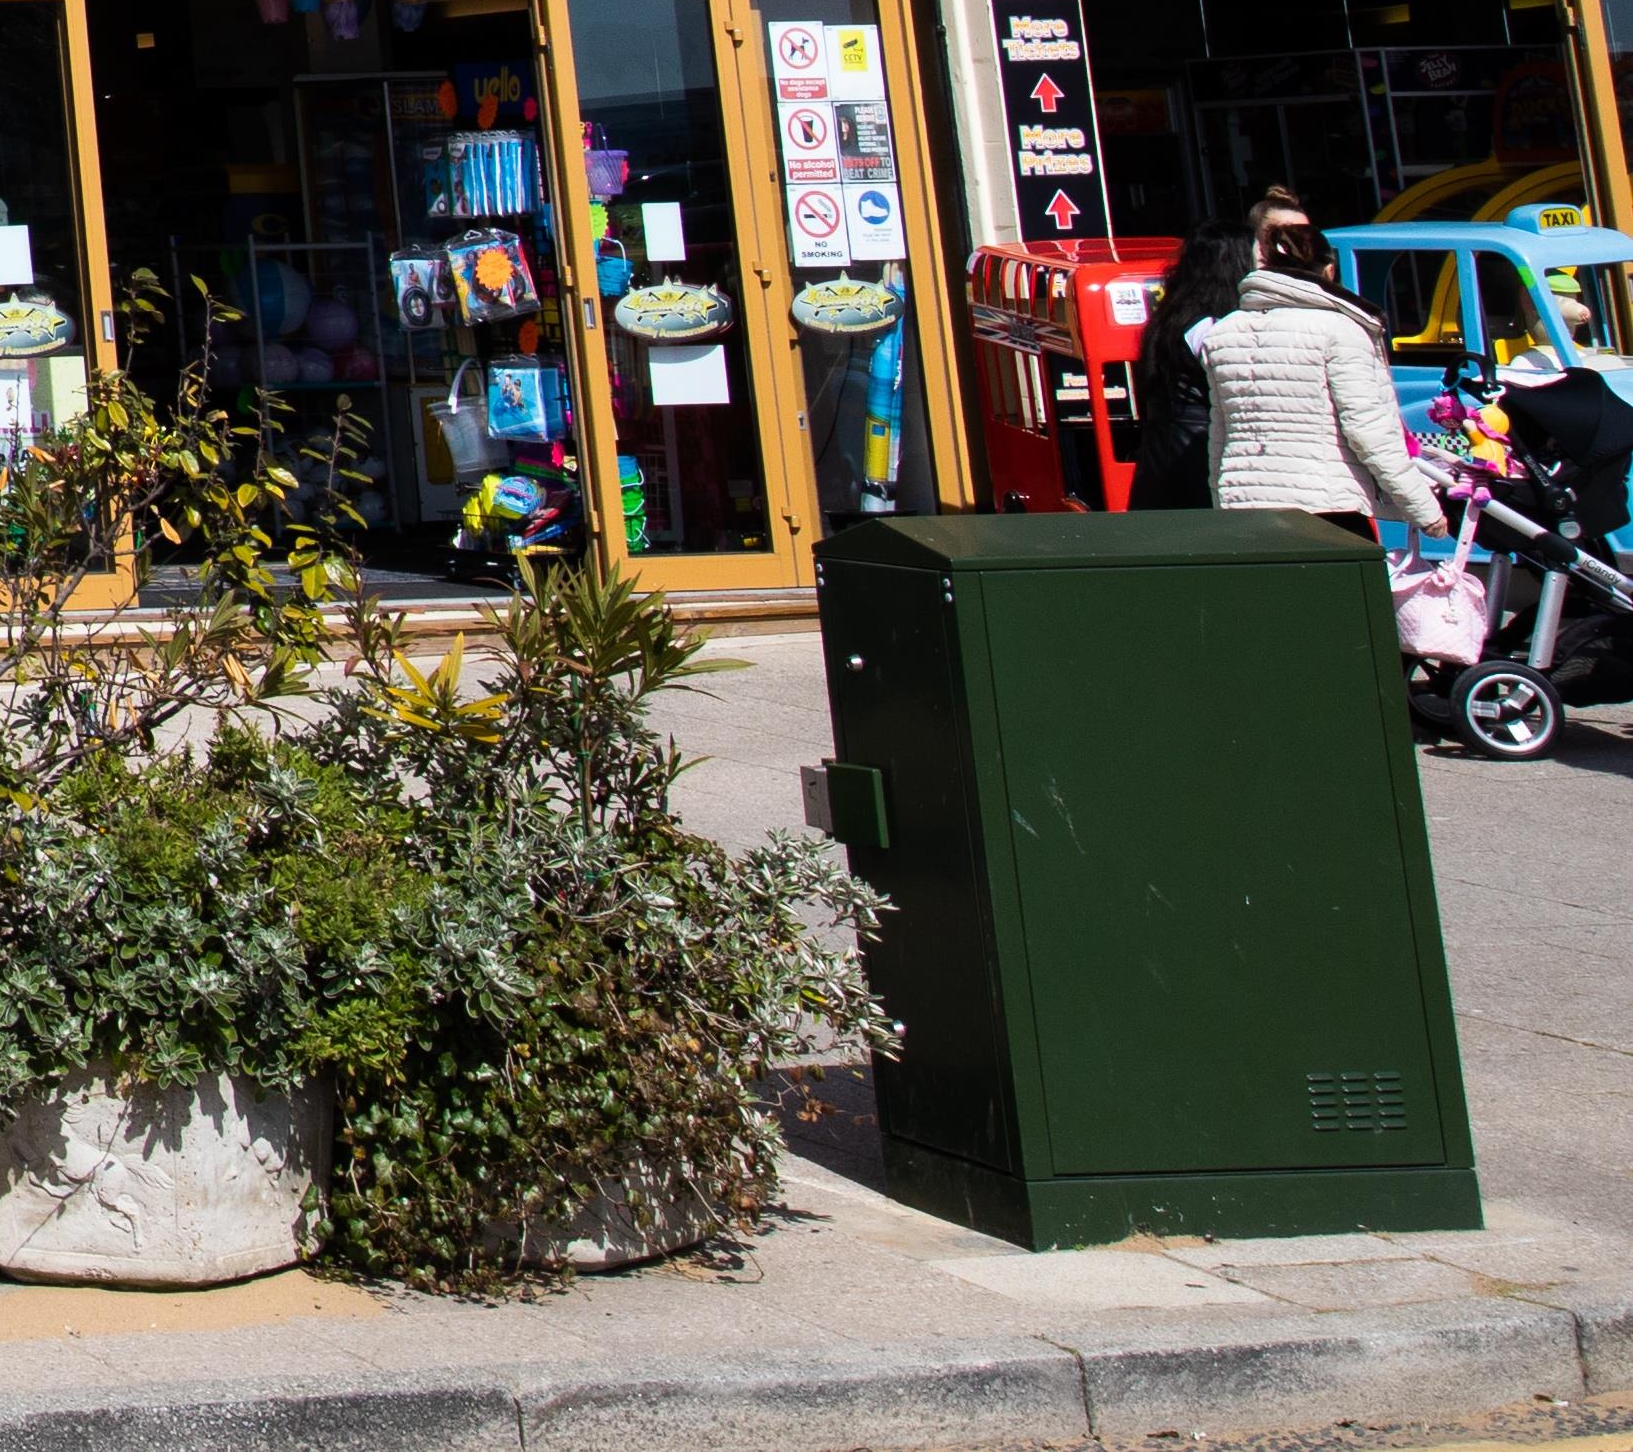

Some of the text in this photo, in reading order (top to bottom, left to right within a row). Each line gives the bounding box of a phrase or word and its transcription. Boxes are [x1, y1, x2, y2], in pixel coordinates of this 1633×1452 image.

[1009, 15, 1069, 38] More
[1002, 38, 1081, 62] Tickets
[1019, 125, 1085, 150] More
[789, 160, 835, 169] No alcohol
[880, 157, 892, 166] TO
[1018, 150, 1093, 175] Prizes
[792, 169, 834, 180] permitted
[844, 168, 893, 179] BEAT CRIME
[1543, 212, 1575, 227] TAXI
[801, 251, 843, 259] SMOKING
[1582, 558, 1622, 585] iCandy
